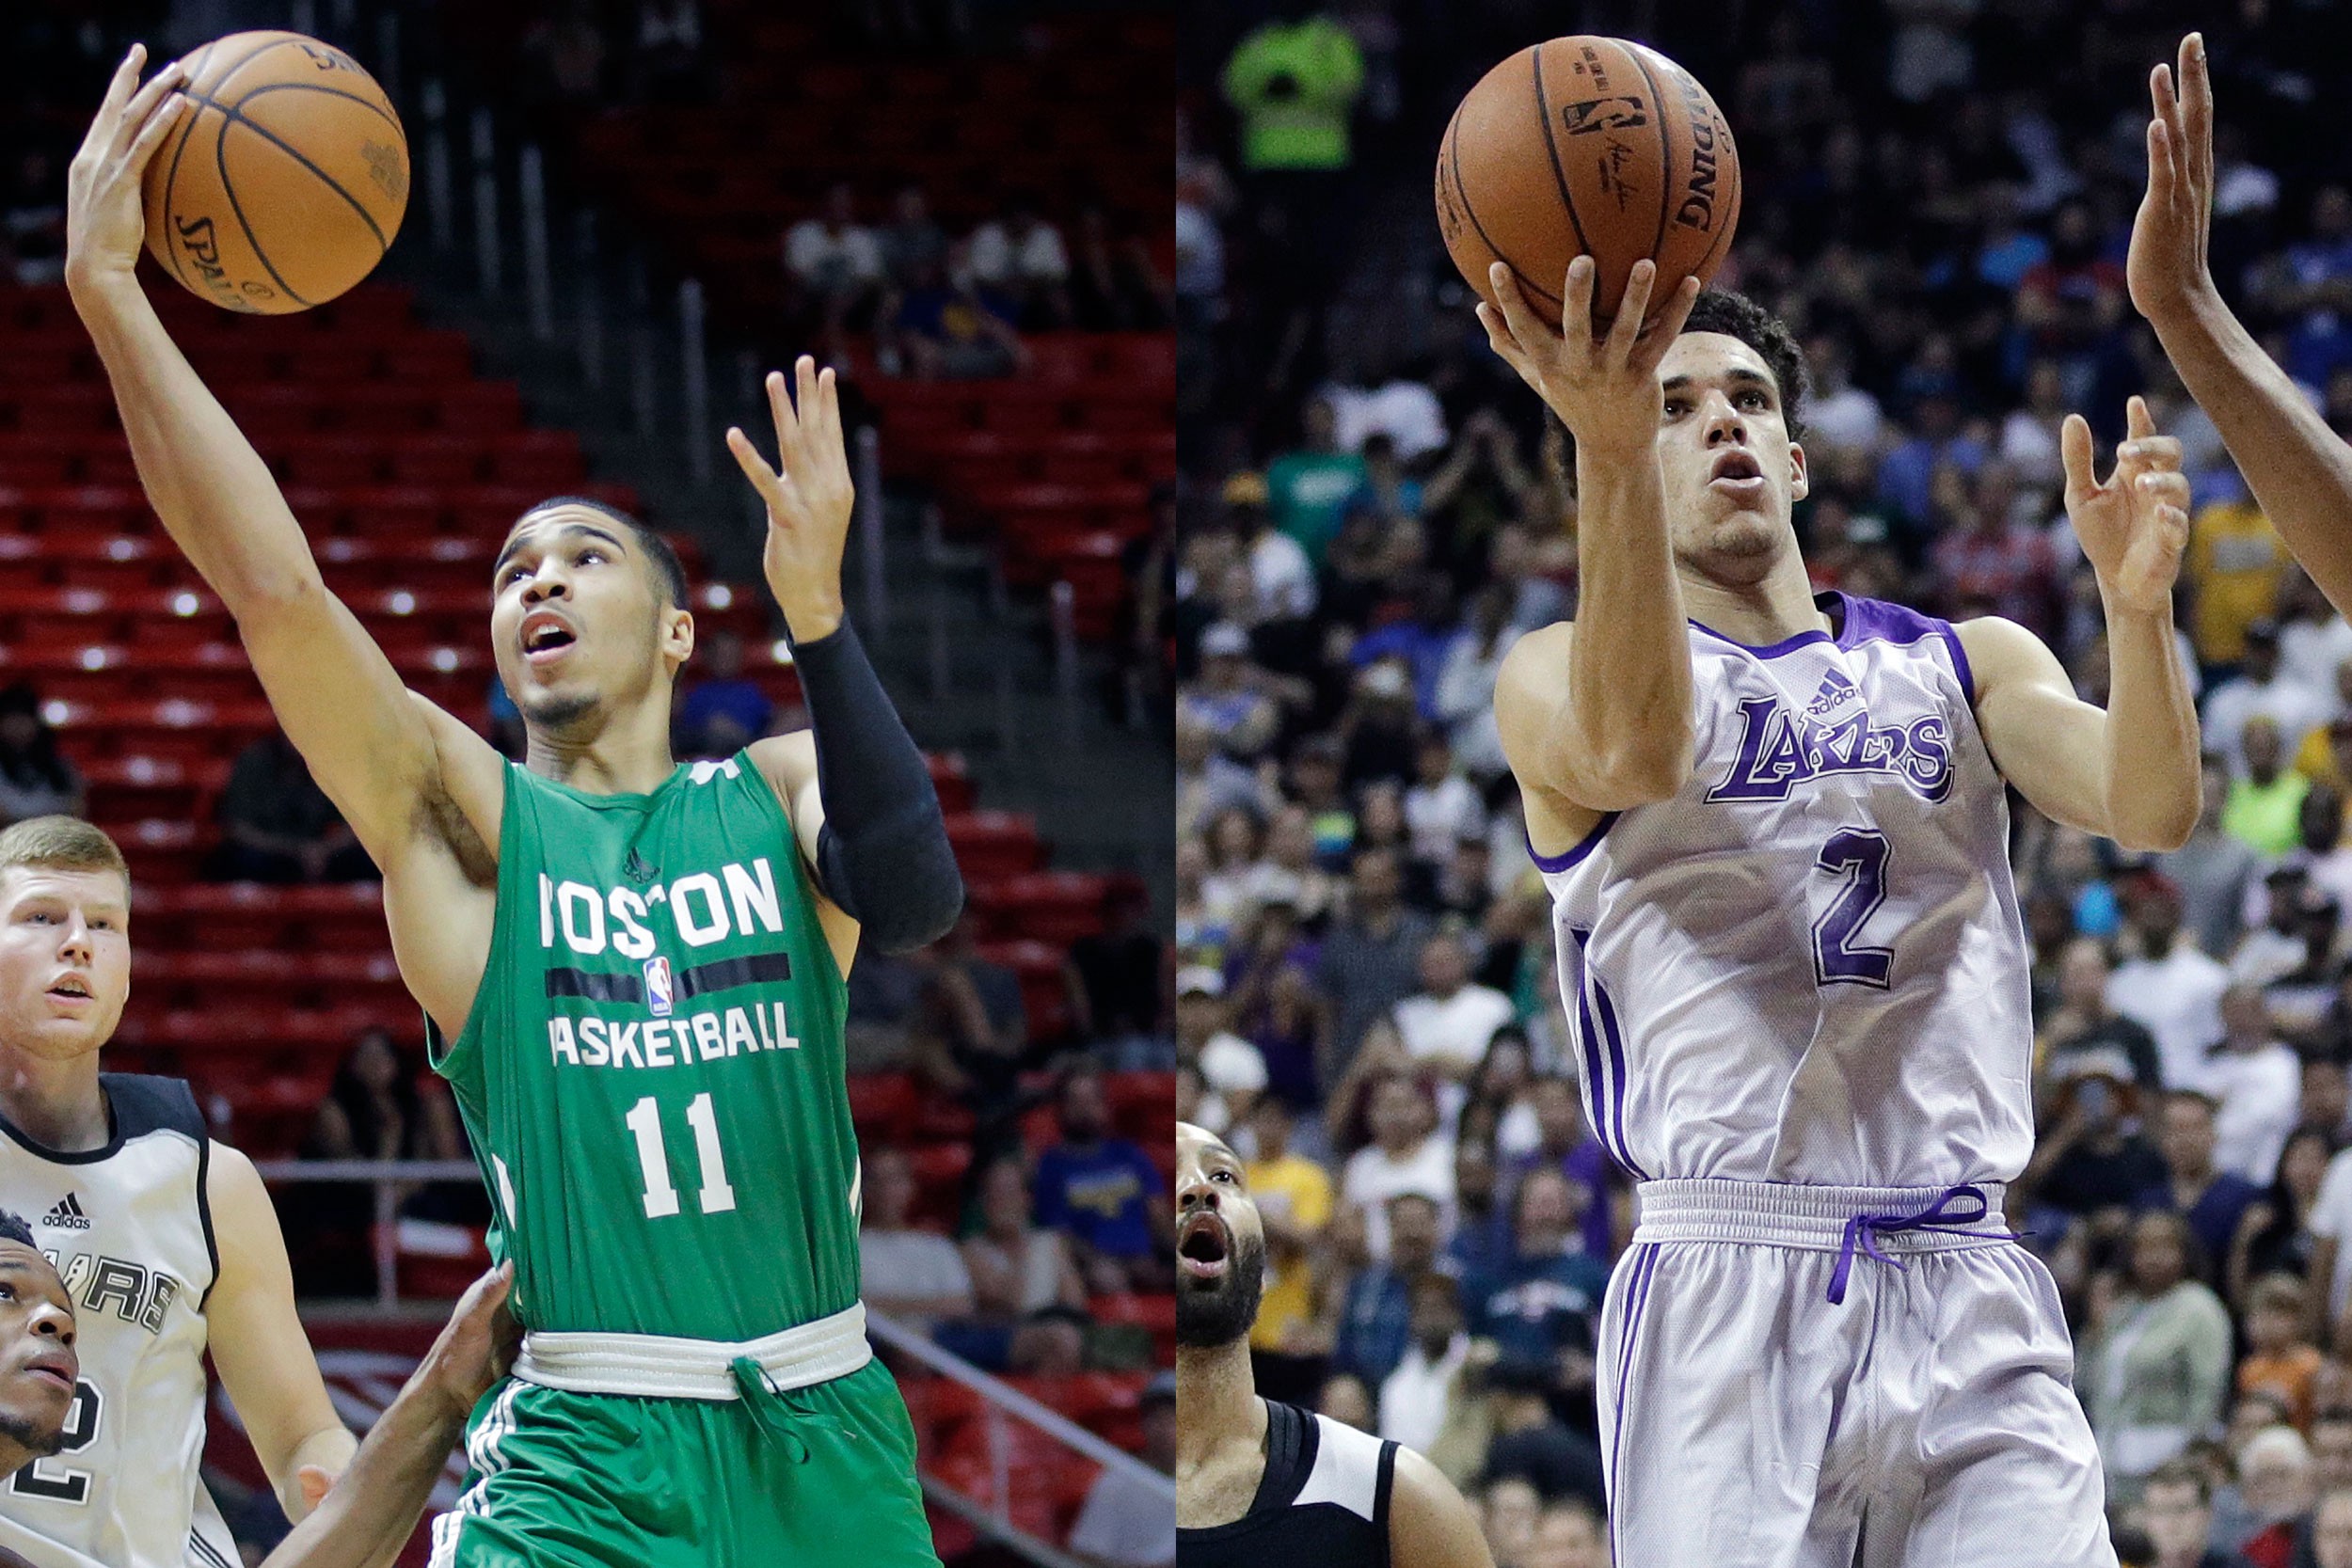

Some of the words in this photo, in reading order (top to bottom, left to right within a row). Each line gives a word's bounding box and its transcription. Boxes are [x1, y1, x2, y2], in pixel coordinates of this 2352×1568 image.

[1675, 70, 1717, 232] PALDING
[539, 858, 783, 959] OSON
[1812, 827, 1894, 990] 2
[548, 1002, 800, 1069] ASKETBALL
[626, 1092, 737, 1219] 11
[42, 1213, 90, 1229] adidas
